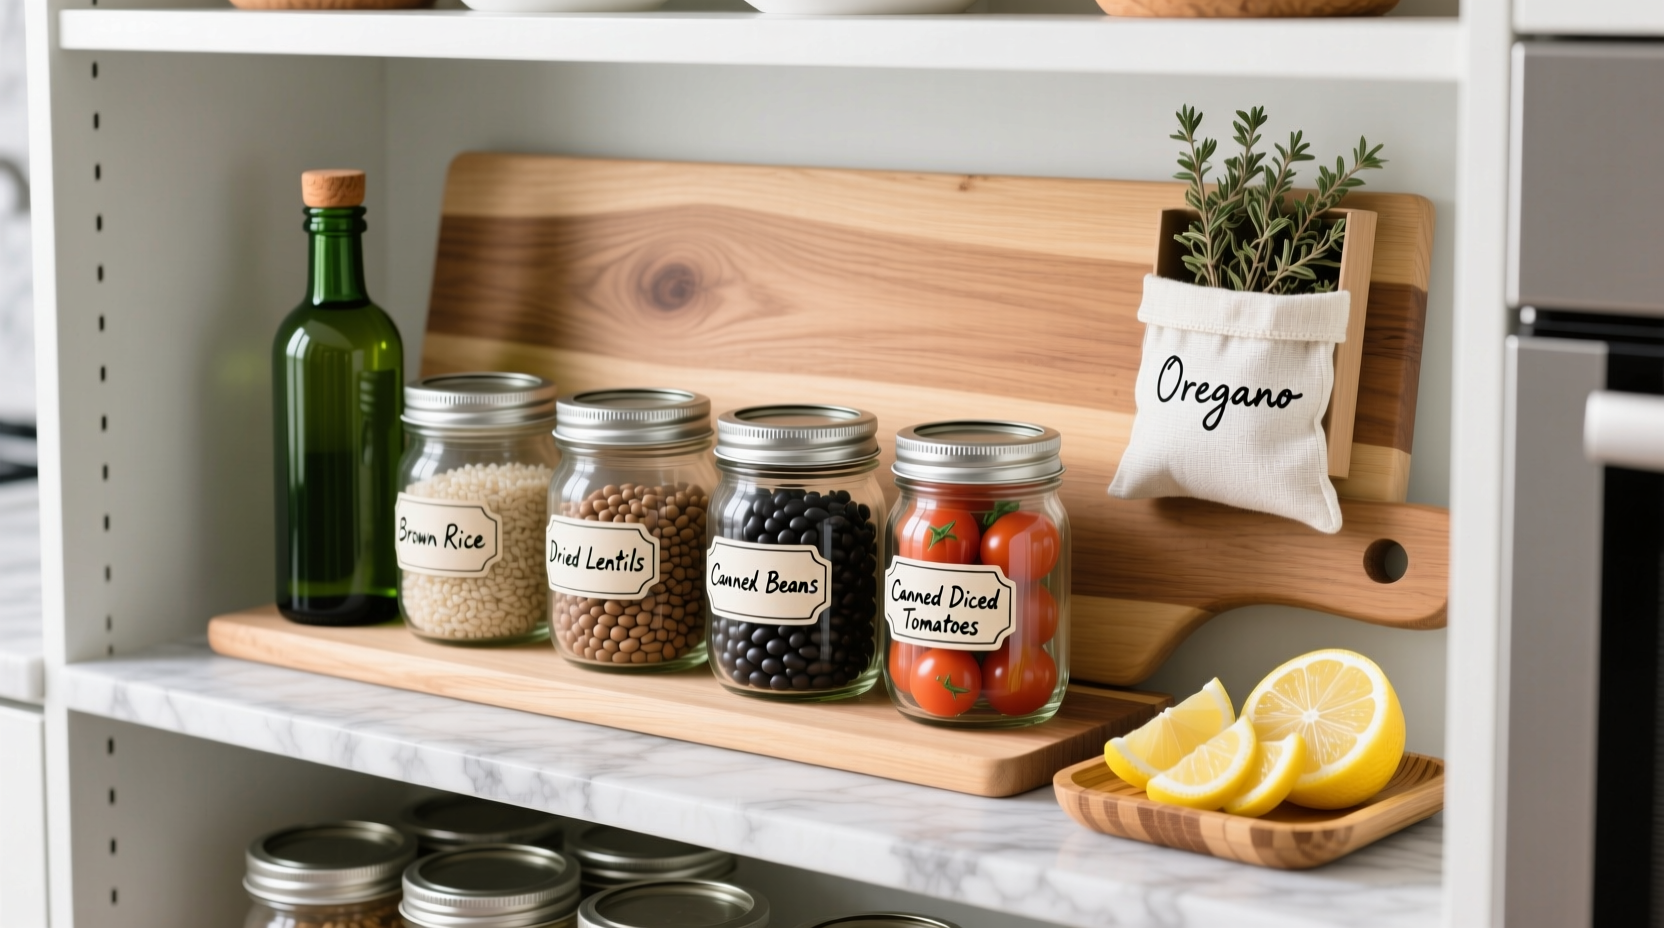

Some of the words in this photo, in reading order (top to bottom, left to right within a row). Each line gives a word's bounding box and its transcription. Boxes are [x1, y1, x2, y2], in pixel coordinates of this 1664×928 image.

[1157, 355, 1303, 431] Oregano
[398, 517, 437, 547] Brown
[444, 523, 486, 549] Rice
[549, 540, 580, 568] Dried
[586, 546, 644, 572] Lentils
[766, 570, 818, 594] Beans
[891, 579, 943, 606] Canned
[949, 586, 1000, 610] Diced
[903, 608, 979, 636] Tomatoes
